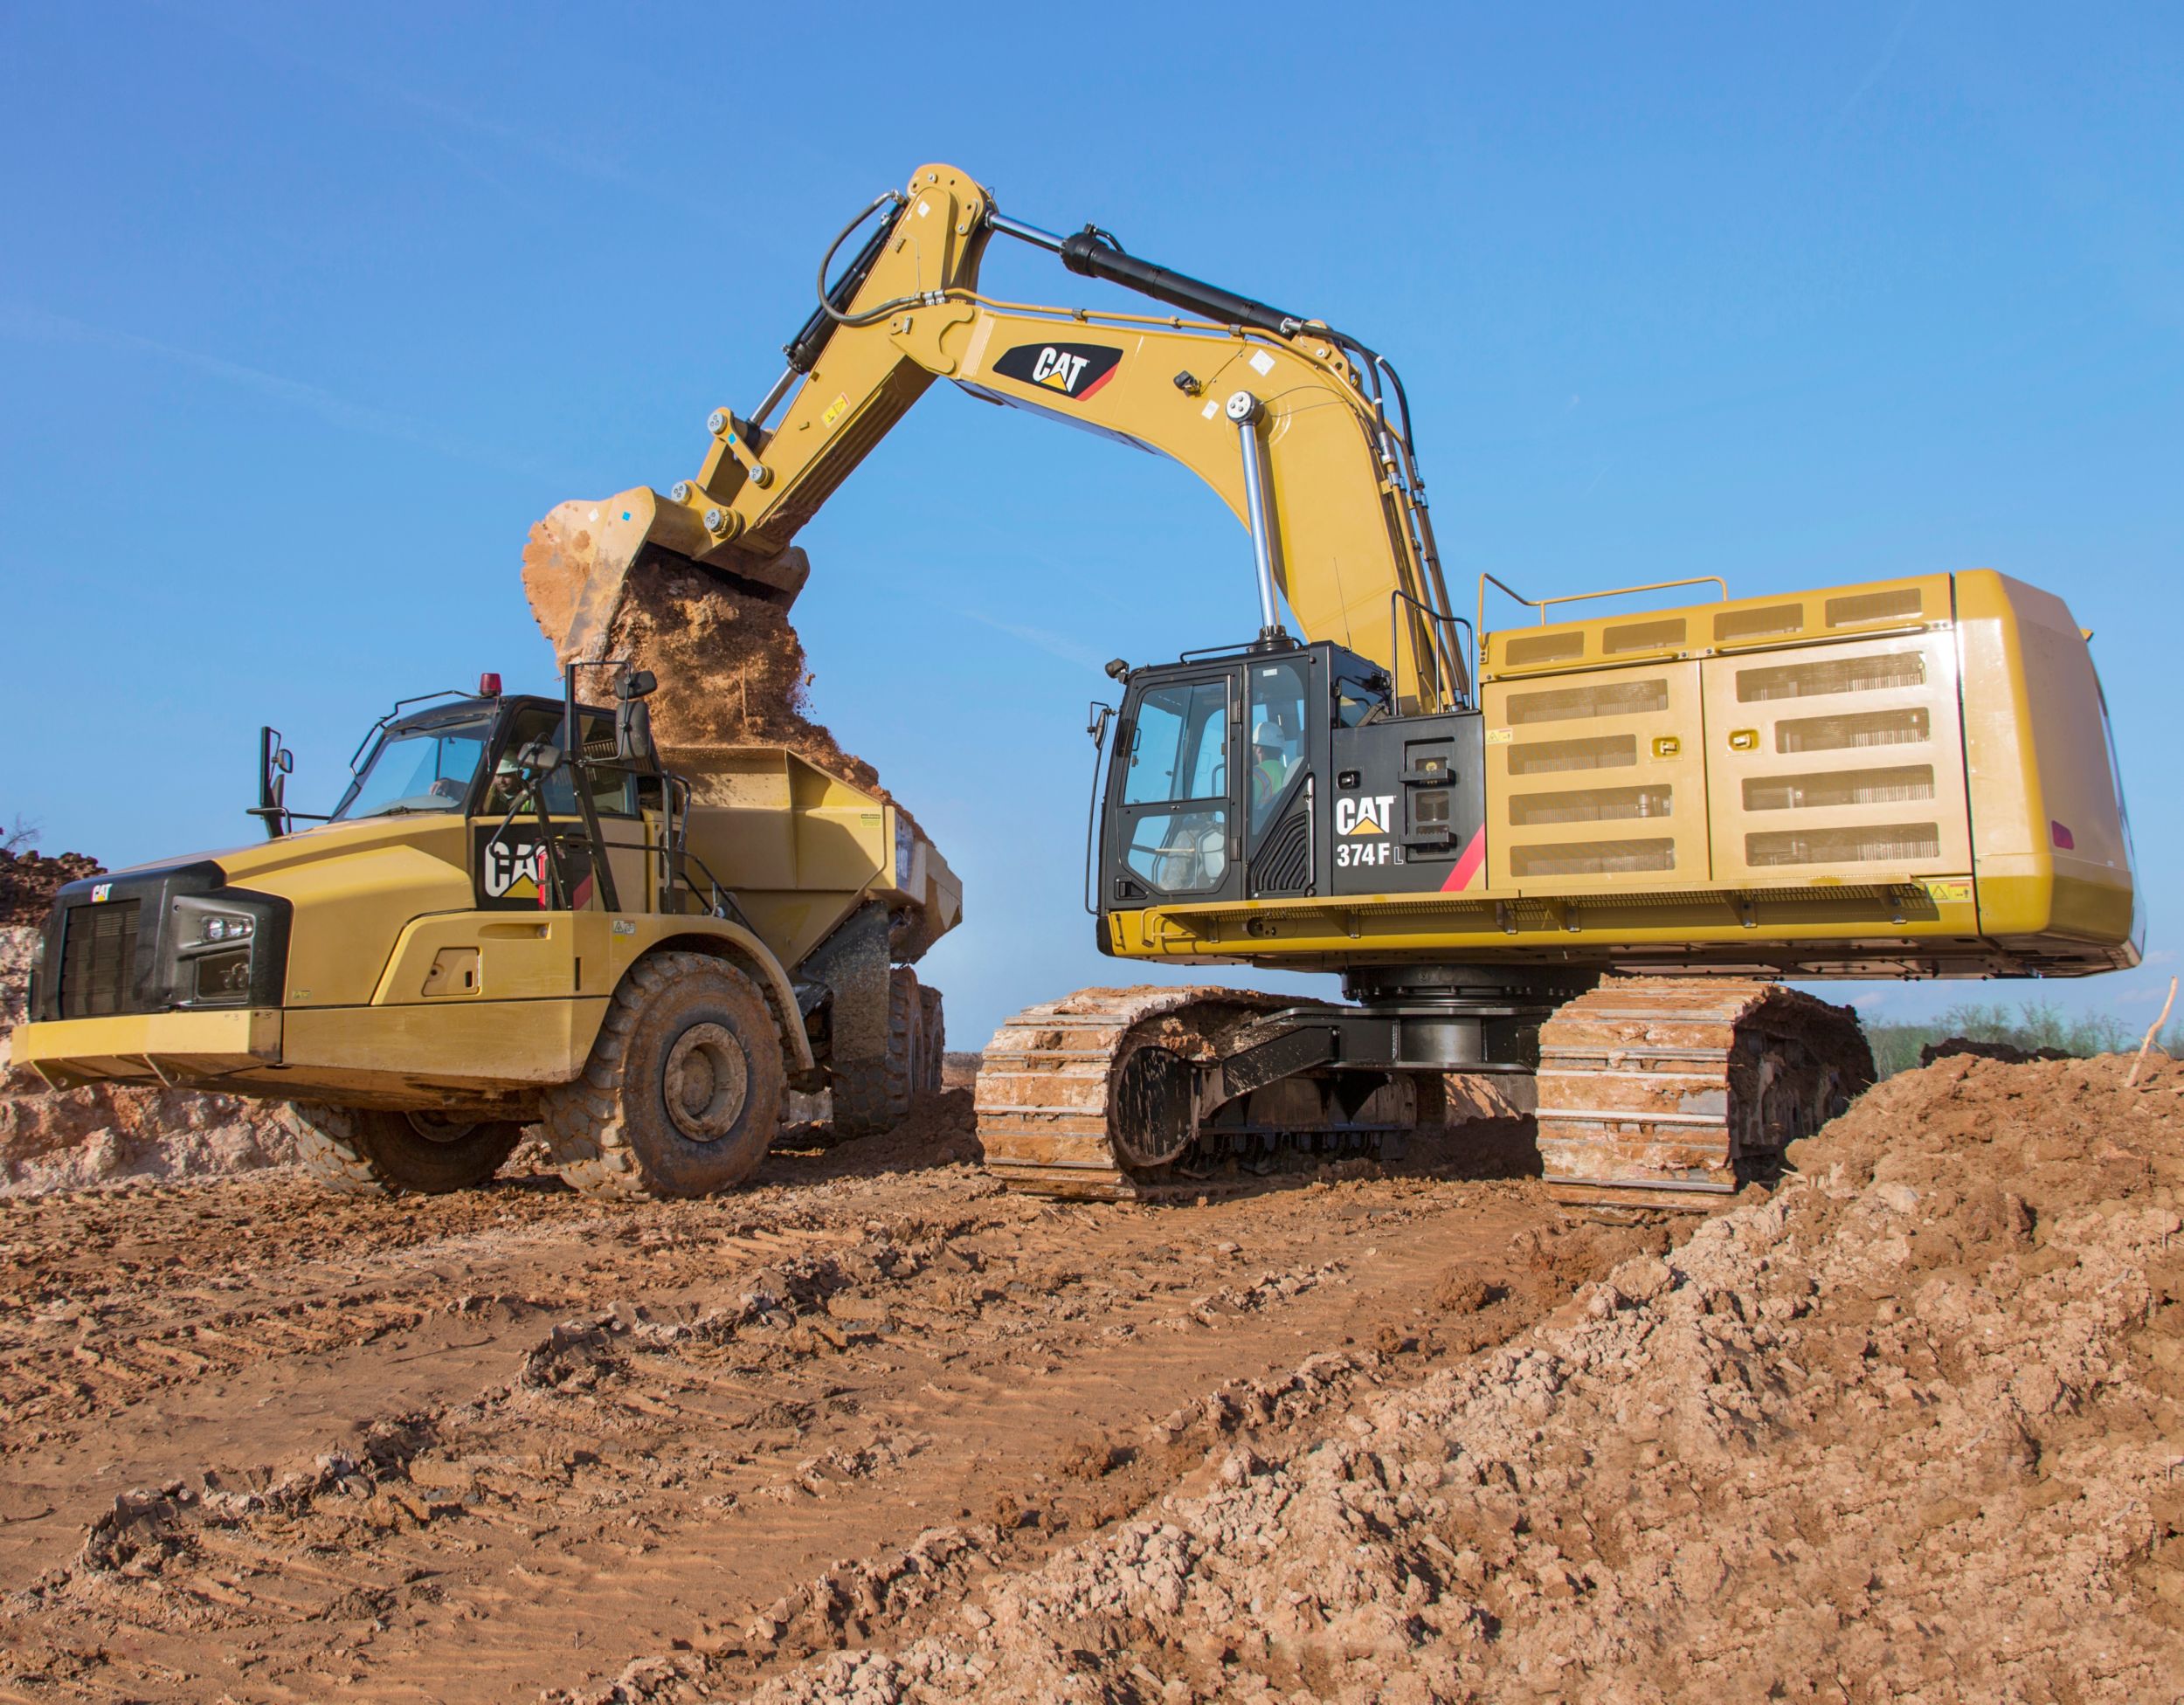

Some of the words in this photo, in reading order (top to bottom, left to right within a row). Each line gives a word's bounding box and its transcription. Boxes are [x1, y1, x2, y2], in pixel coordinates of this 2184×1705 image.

[1033, 347, 1089, 392] CAT
[1336, 795, 1395, 835] CAT
[92, 883, 113, 902] CAT
